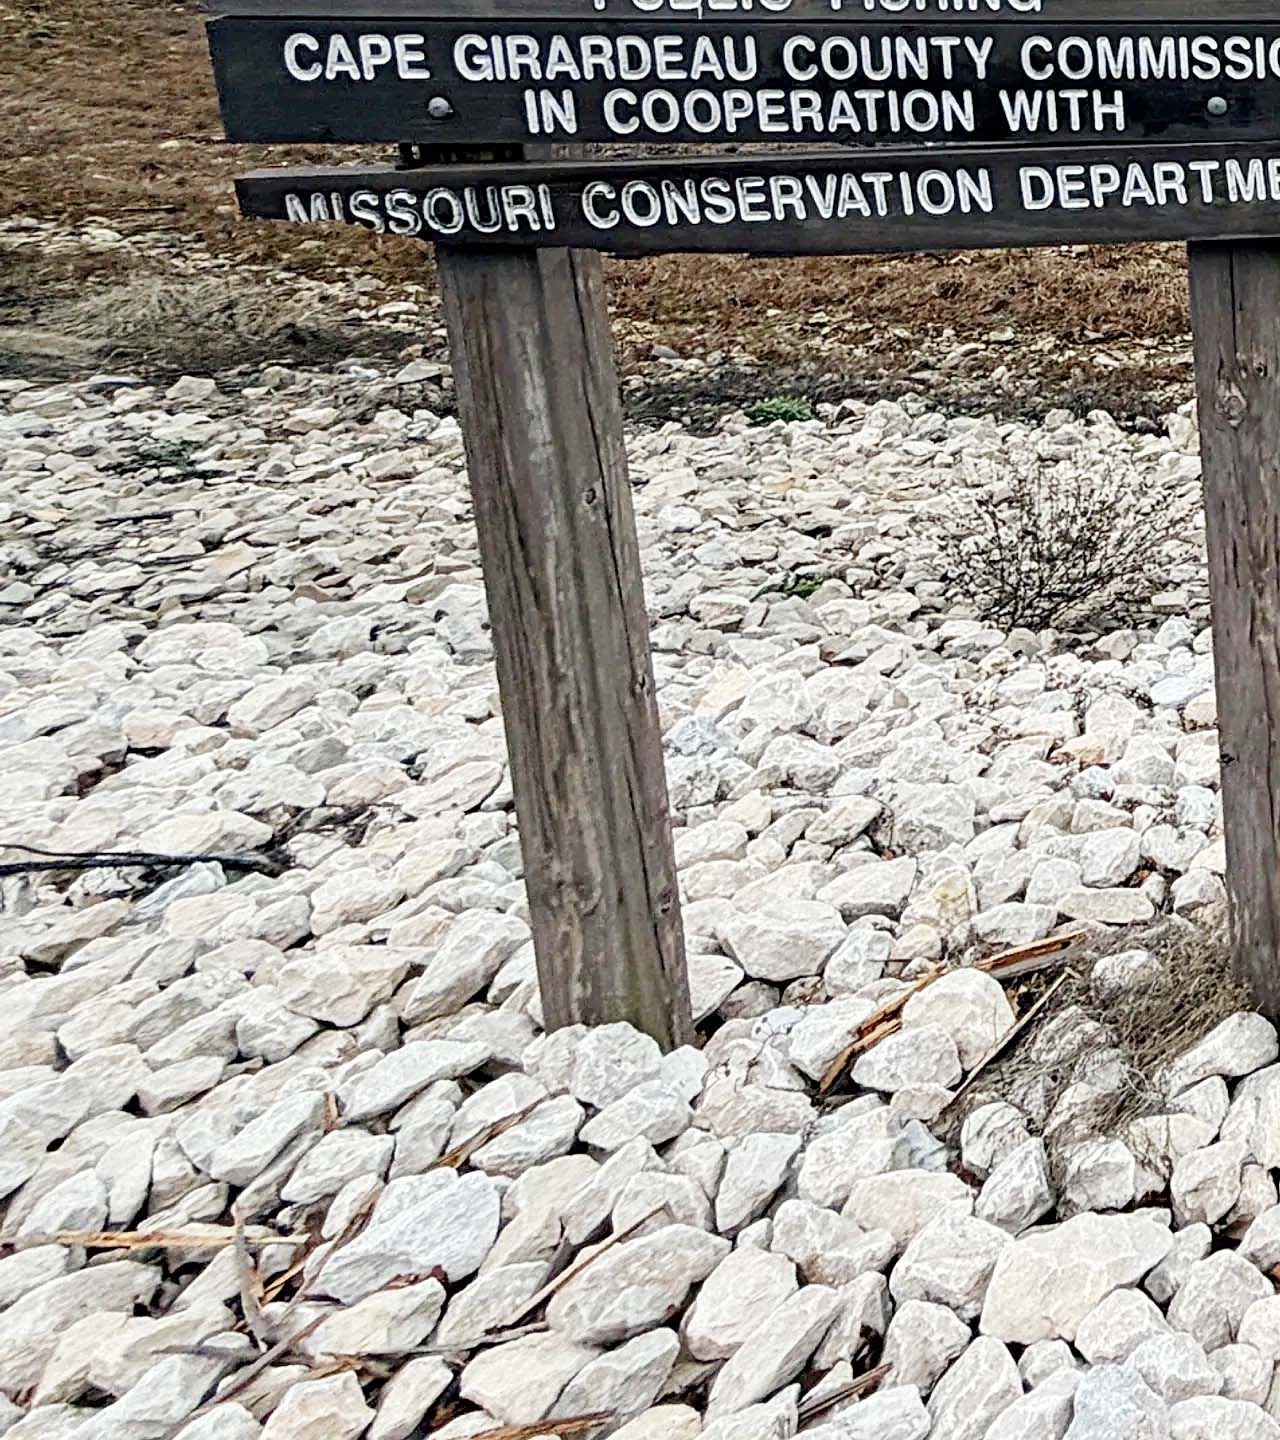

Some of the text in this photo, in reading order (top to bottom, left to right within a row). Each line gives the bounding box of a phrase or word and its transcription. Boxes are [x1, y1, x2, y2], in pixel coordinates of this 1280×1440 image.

[283, 32, 431, 82] CAPE
[453, 33, 758, 82] GIRARDEAU
[782, 34, 994, 82] COUNTY
[523, 87, 1125, 135] IN COOPERATION WITH
[283, 183, 556, 237] MISSOURI
[580, 166, 994, 231] CONSERVATION
